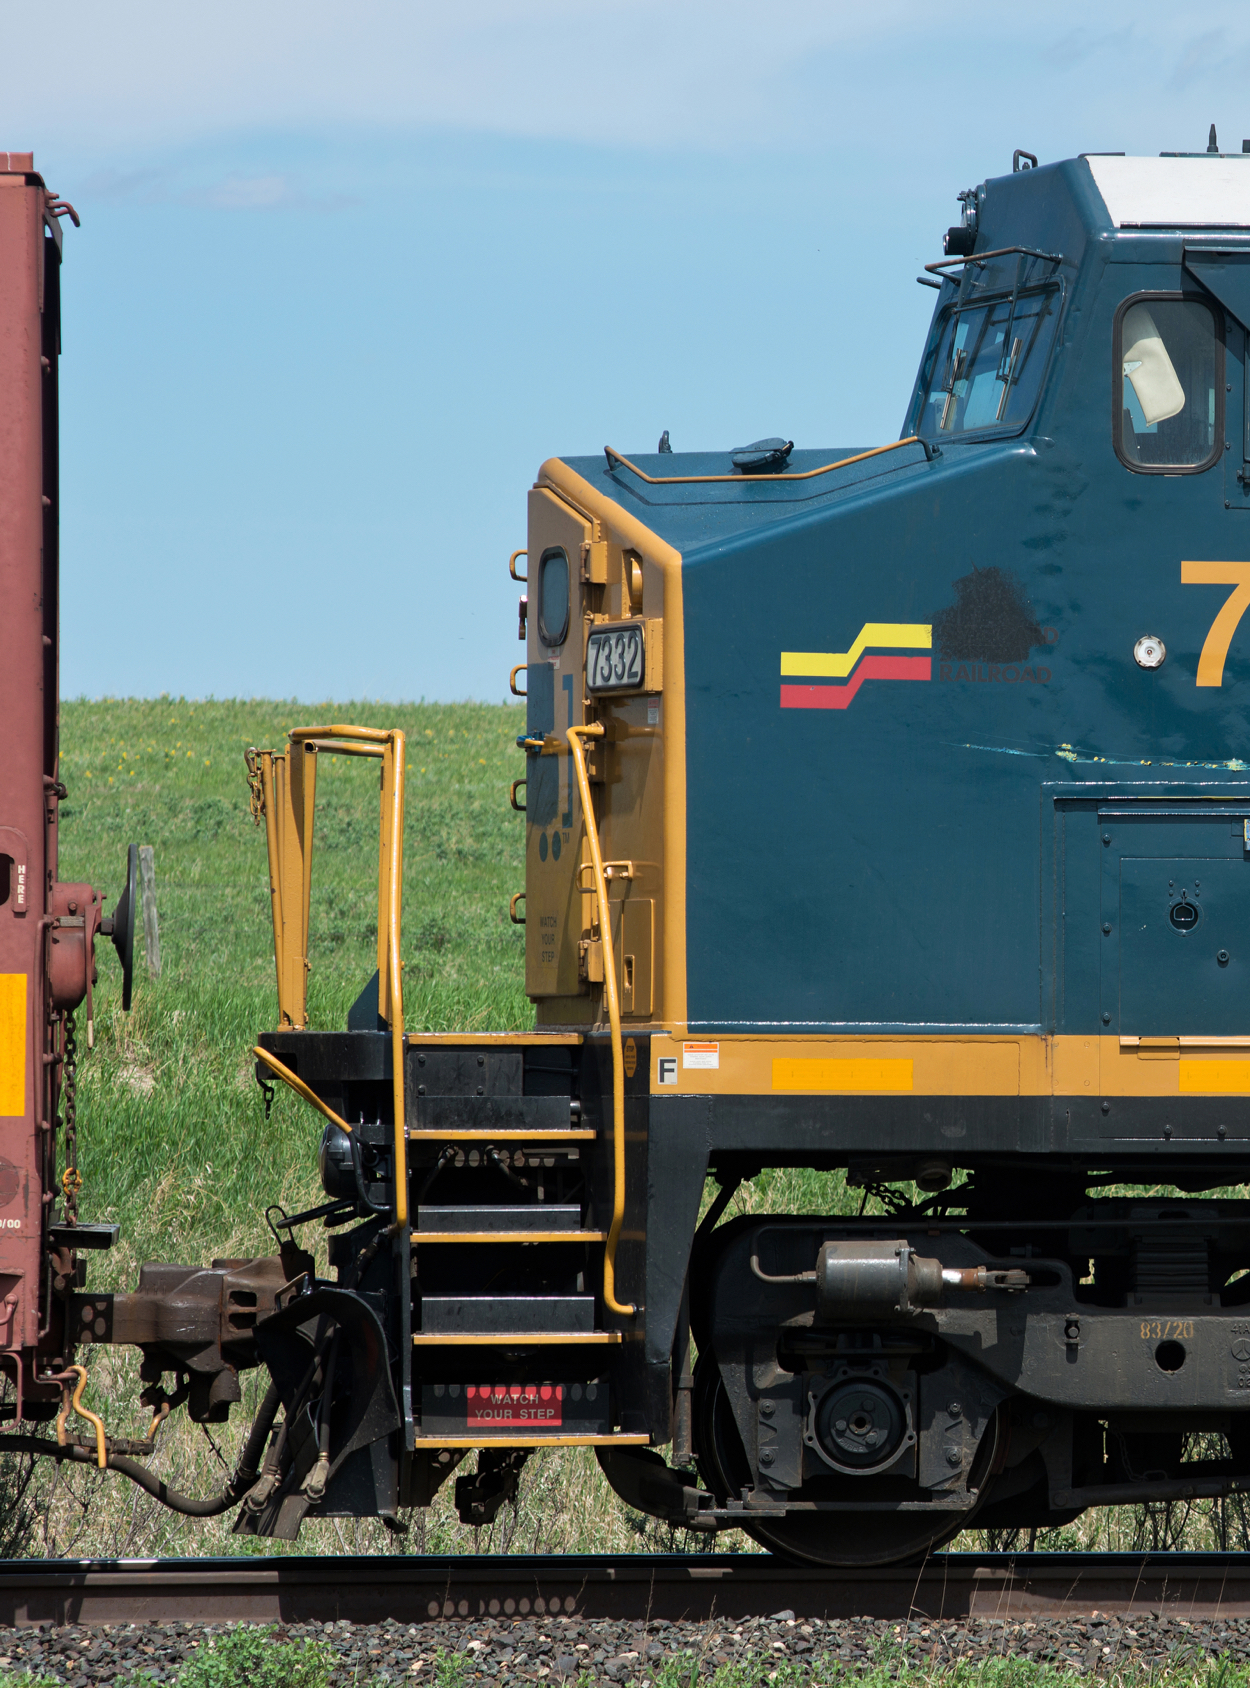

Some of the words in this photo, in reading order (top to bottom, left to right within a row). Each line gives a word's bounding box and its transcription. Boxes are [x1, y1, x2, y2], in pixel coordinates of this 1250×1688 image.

[590, 630, 639, 685] 7332
[940, 664, 1052, 684] RAILROAD
[17, 865, 26, 904] HERE
[540, 916, 557, 928] WATCH
[541, 933, 555, 945] YOUR
[541, 951, 554, 962] STEP
[659, 1058, 676, 1083] F
[1140, 1322, 1194, 1339] 83/20
[490, 1394, 539, 1405] WATCH
[475, 1409, 513, 1420] YOUR
[519, 1409, 555, 1420] STEP
